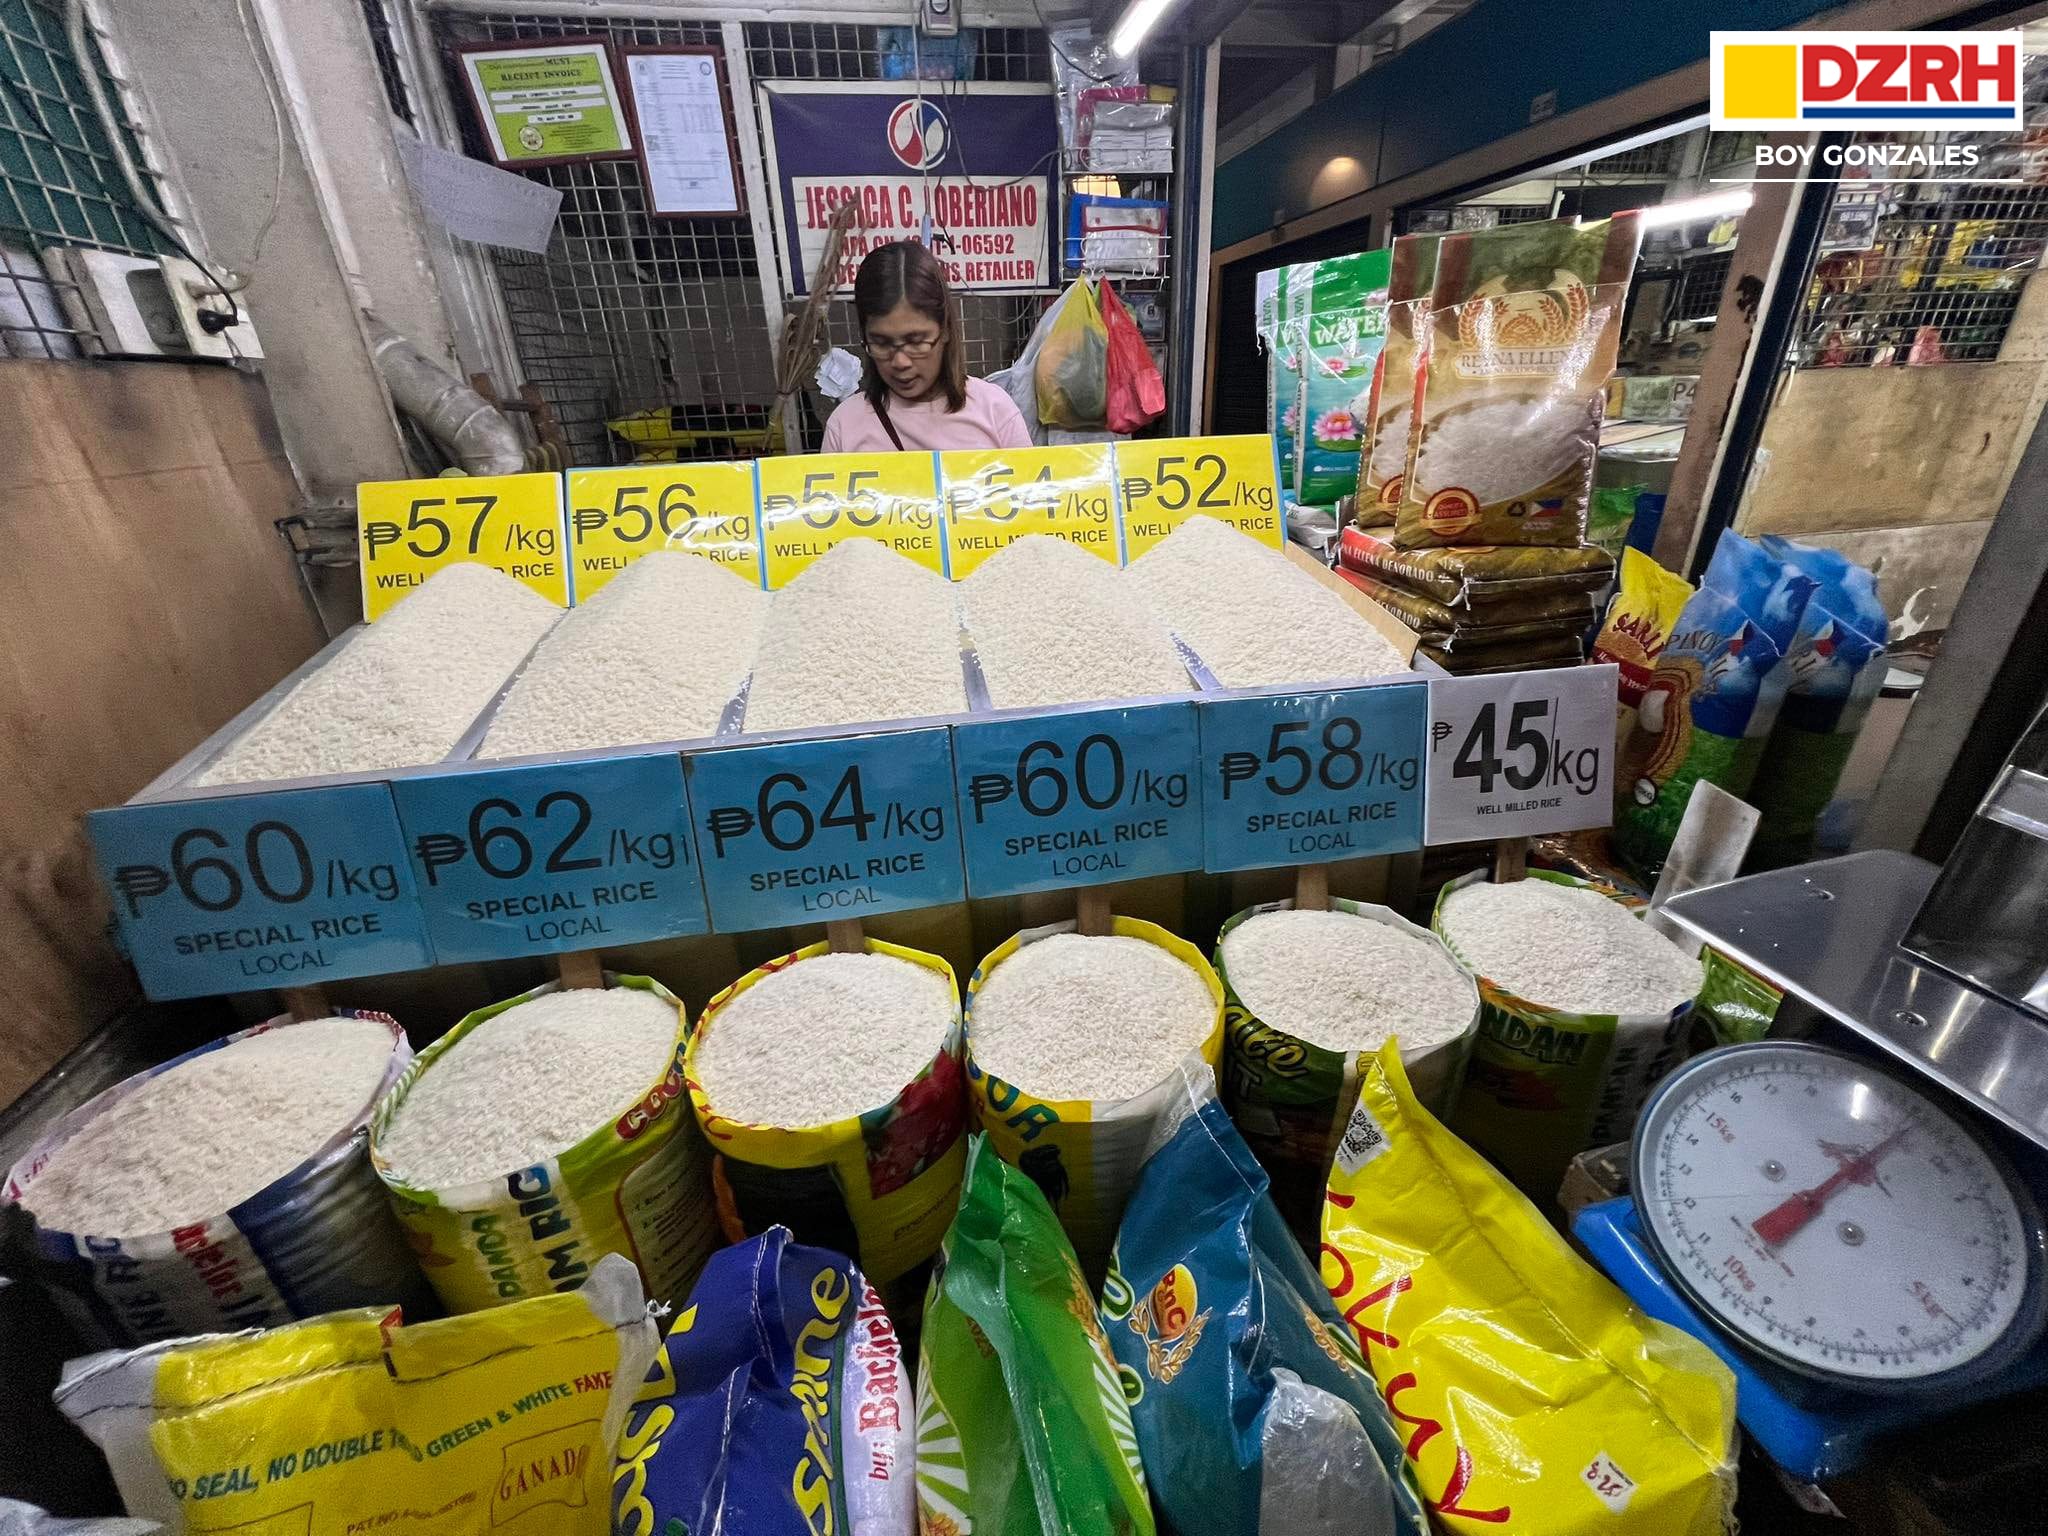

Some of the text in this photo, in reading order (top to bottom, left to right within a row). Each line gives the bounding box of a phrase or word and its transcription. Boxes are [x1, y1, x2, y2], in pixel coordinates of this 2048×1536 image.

[805, 184, 894, 229] JESSICA
[898, 184, 919, 228] C.
[965, 260, 1034, 283] RETAILER
[1520, 349, 1576, 365] ELLEN
[1240, 516, 1274, 531] RICE
[775, 542, 822, 557] WELL
[894, 536, 932, 551] RICE
[958, 535, 1005, 550] WELL
[1071, 529, 1108, 544] RICE
[710, 550, 749, 563] RICE
[512, 563, 555, 578] RICE
[1247, 801, 1398, 833] SPECIAL RICE
[1476, 797, 1561, 817] WELL MILLED RICE
[1005, 819, 1169, 857] SPECIAL RICE
[1288, 831, 1356, 854] LOCAL
[750, 853, 926, 892] SPECIAL RICE
[1053, 853, 1128, 876] LOCAL
[466, 880, 658, 922] SPECIAL RICE
[802, 886, 882, 912] LOCAL
[174, 913, 383, 957] SPECIAL RICE
[525, 914, 612, 943] LOCAL
[239, 949, 333, 978] LOCAL
[426, 1417, 493, 1458] GREEN
[496, 1410, 512, 1424] &
[513, 1383, 573, 1415] WHITE
[573, 1371, 614, 1394] FAKE
[192, 1465, 259, 1500] SEAL,
[267, 1453, 297, 1483] NO
[302, 1431, 385, 1473] DOUBLE
